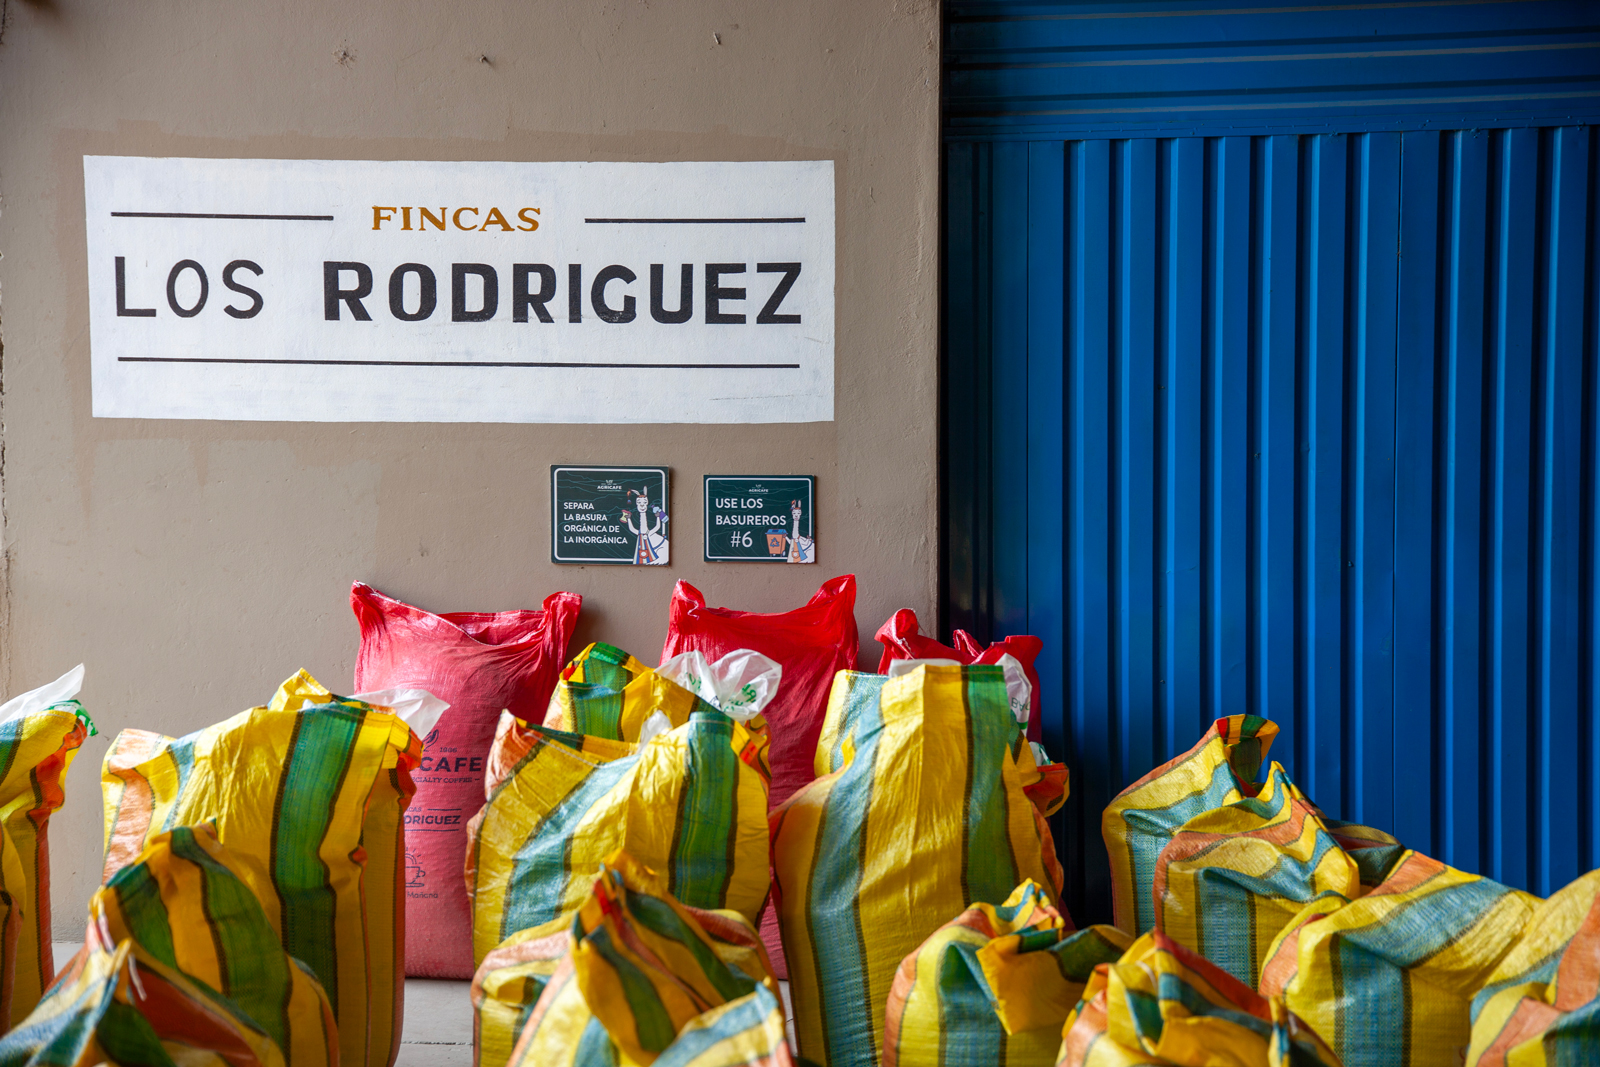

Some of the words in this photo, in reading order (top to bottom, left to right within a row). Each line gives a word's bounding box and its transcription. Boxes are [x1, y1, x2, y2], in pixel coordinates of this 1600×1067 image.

[370, 205, 541, 232] FINCAS
[115, 256, 265, 319] LOS
[323, 261, 802, 325] RODRIGUEZ
[563, 501, 595, 510] SEPARA
[715, 498, 738, 509] USE
[741, 498, 763, 509] LOS
[563, 513, 575, 521] LA
[575, 513, 608, 521] BASURA
[715, 515, 787, 526] BASUREROS
[563, 523, 608, 533] ORGÁNICA
[608, 525, 620, 533] DE
[575, 534, 628, 544] INORGÁNICA
[730, 531, 753, 548] #6
[419, 757, 482, 772] CAFE
[443, 776, 473, 784] COFFEE
[404, 815, 461, 825] DRIGUEZ
